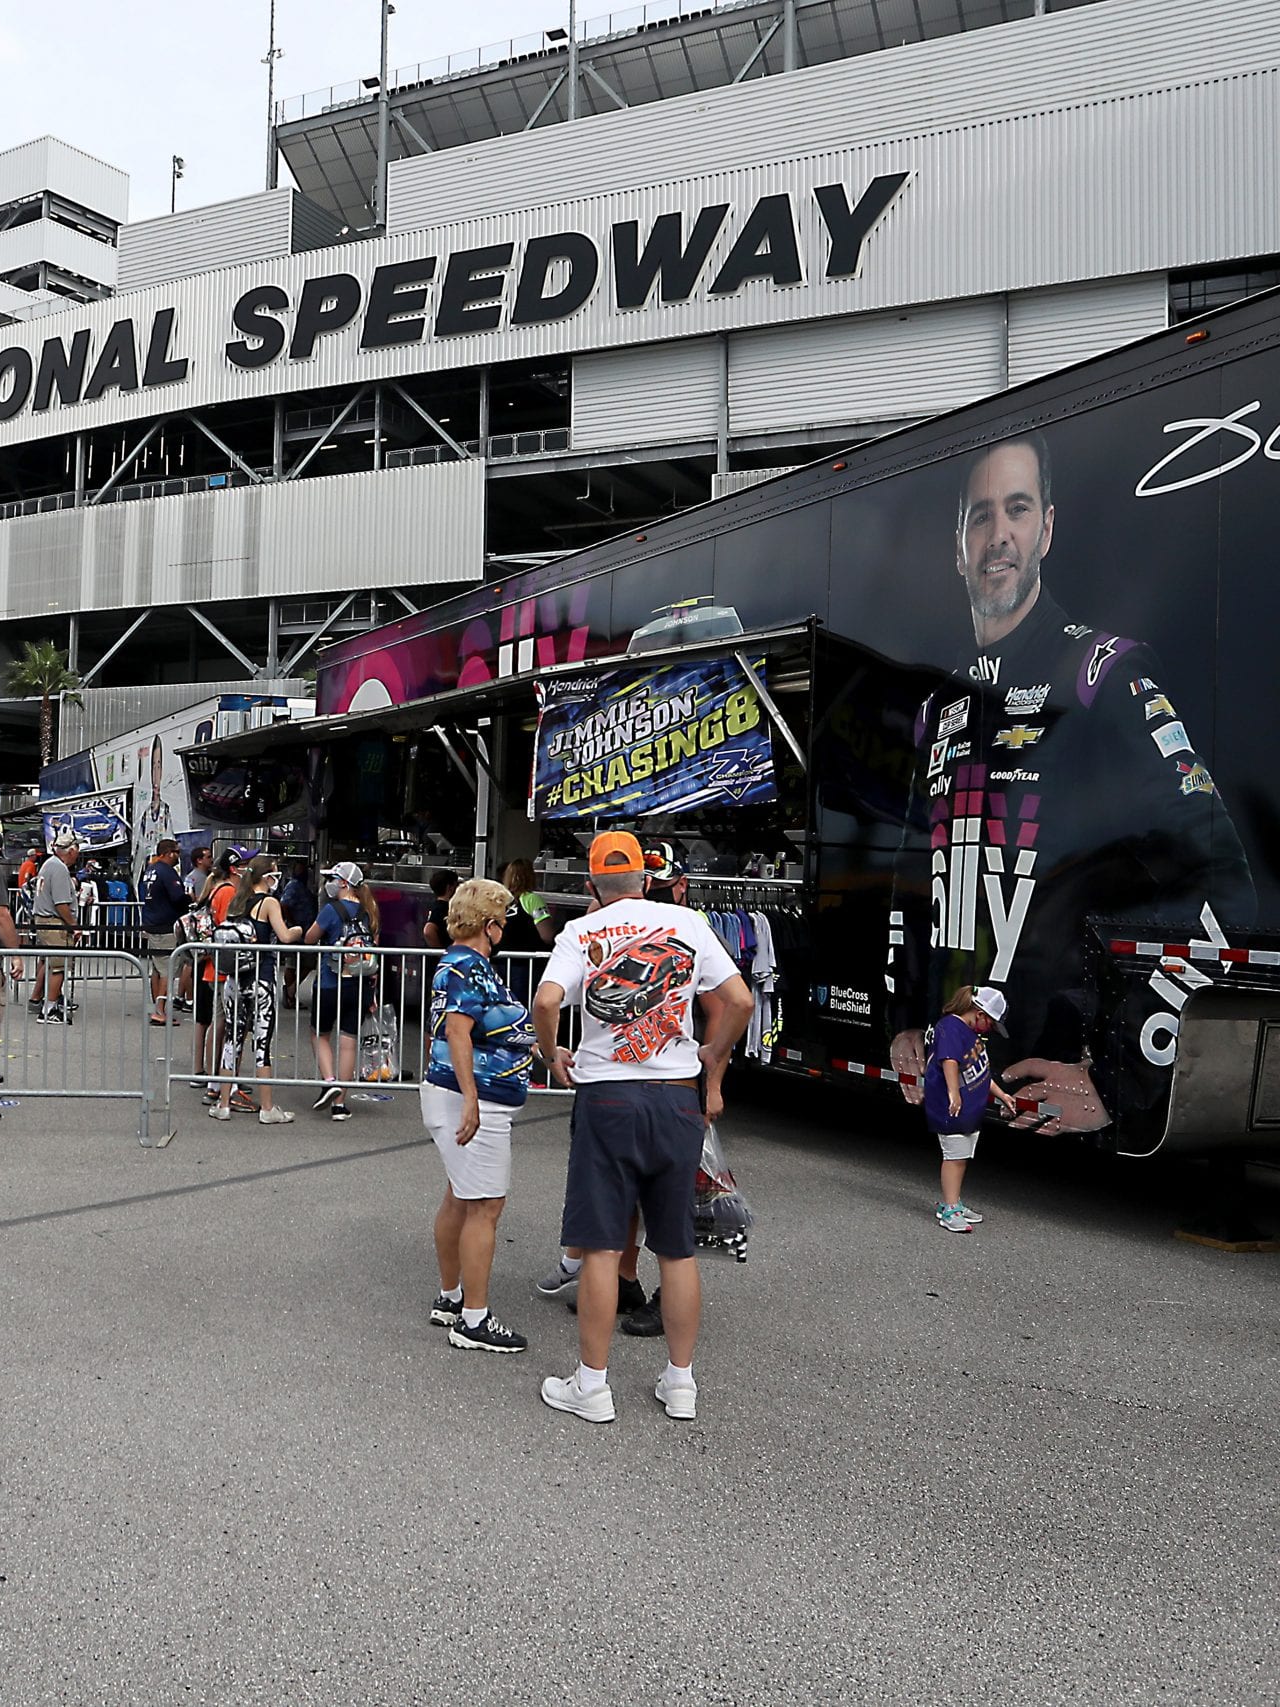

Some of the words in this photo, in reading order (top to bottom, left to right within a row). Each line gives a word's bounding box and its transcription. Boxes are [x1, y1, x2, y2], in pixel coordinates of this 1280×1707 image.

[225, 171, 910, 368] SPEEDWAY
[968, 655, 1002, 685] ally
[548, 677, 598, 696] Hendrick
[549, 688, 650, 757] JIMMIE
[566, 688, 697, 771] JOHNSON
[188, 756, 218, 775] ally
[990, 768, 1040, 782] GOODYEAR
[930, 775, 952, 797] ally
[579, 925, 638, 945] HOOTERS
[830, 985, 869, 1001] BlueCross
[830, 998, 871, 1015] BlueShield
